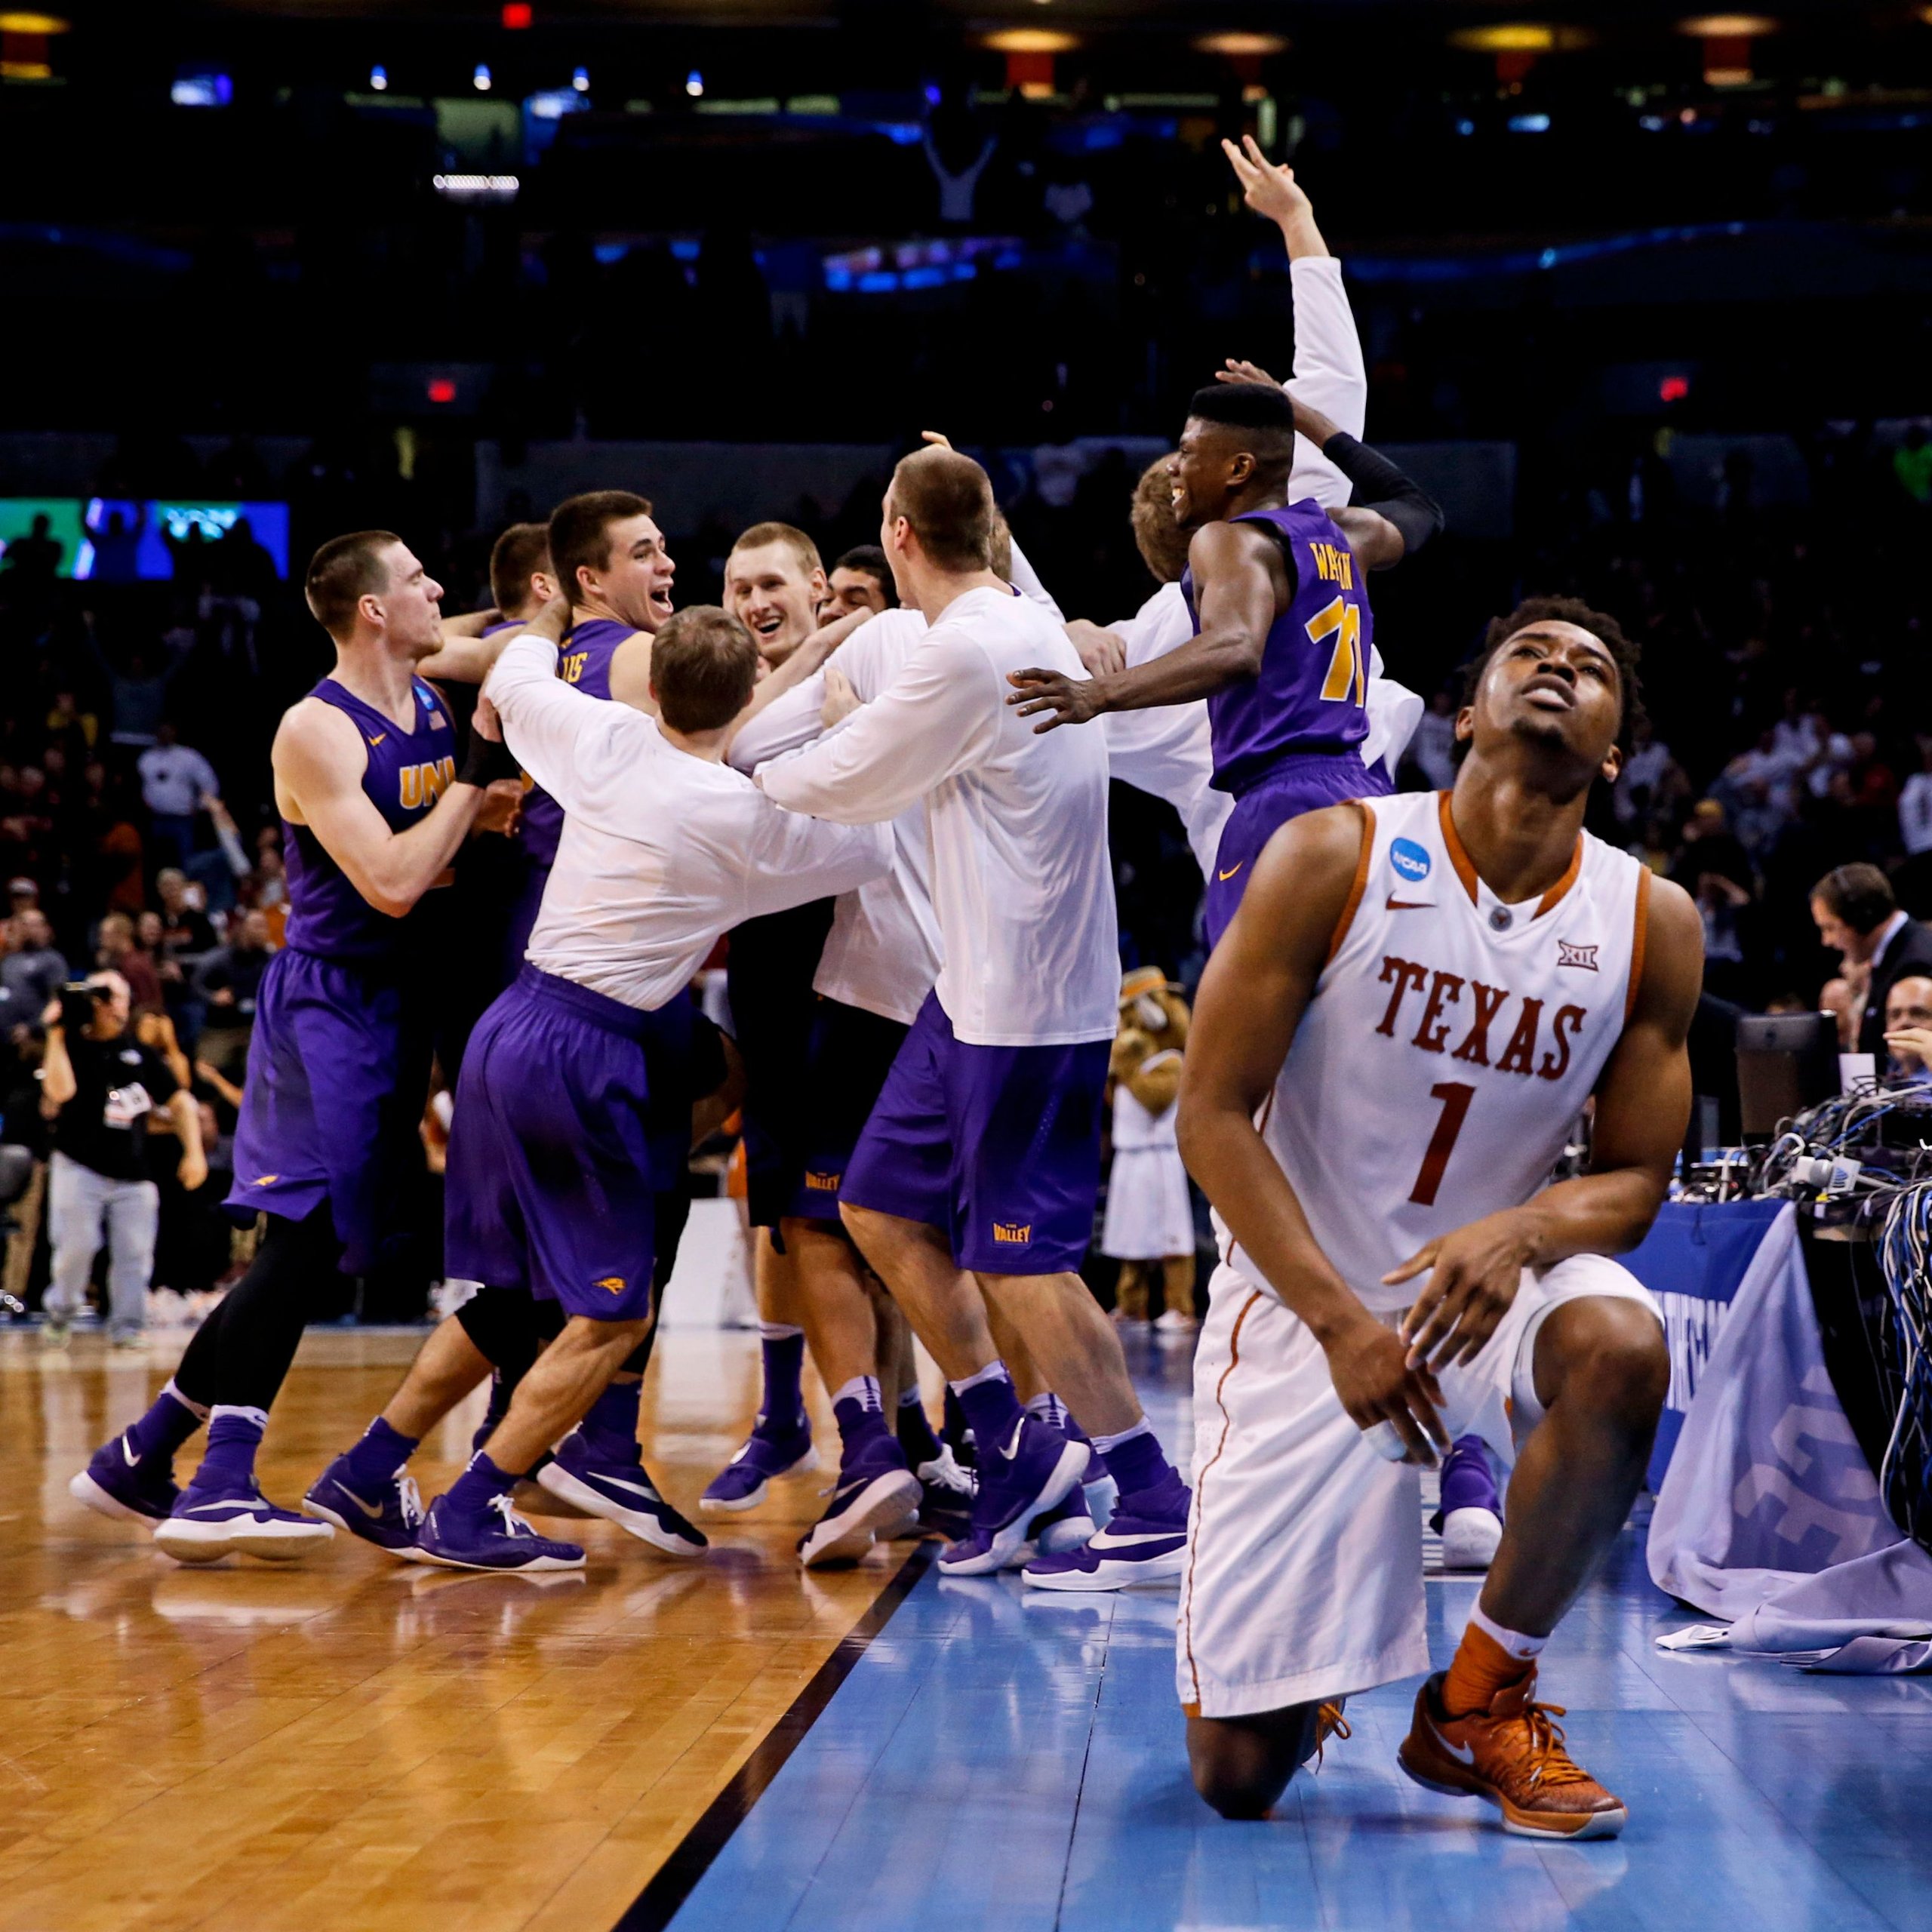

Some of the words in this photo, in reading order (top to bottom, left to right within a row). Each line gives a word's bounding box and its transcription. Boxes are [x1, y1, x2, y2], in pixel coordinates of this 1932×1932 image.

[1393, 851, 1427, 876] NCAA
[1375, 955, 1587, 1081] TEXAS
[1408, 1081, 1477, 1207] 1
[993, 1223, 1031, 1244] VALLEY
